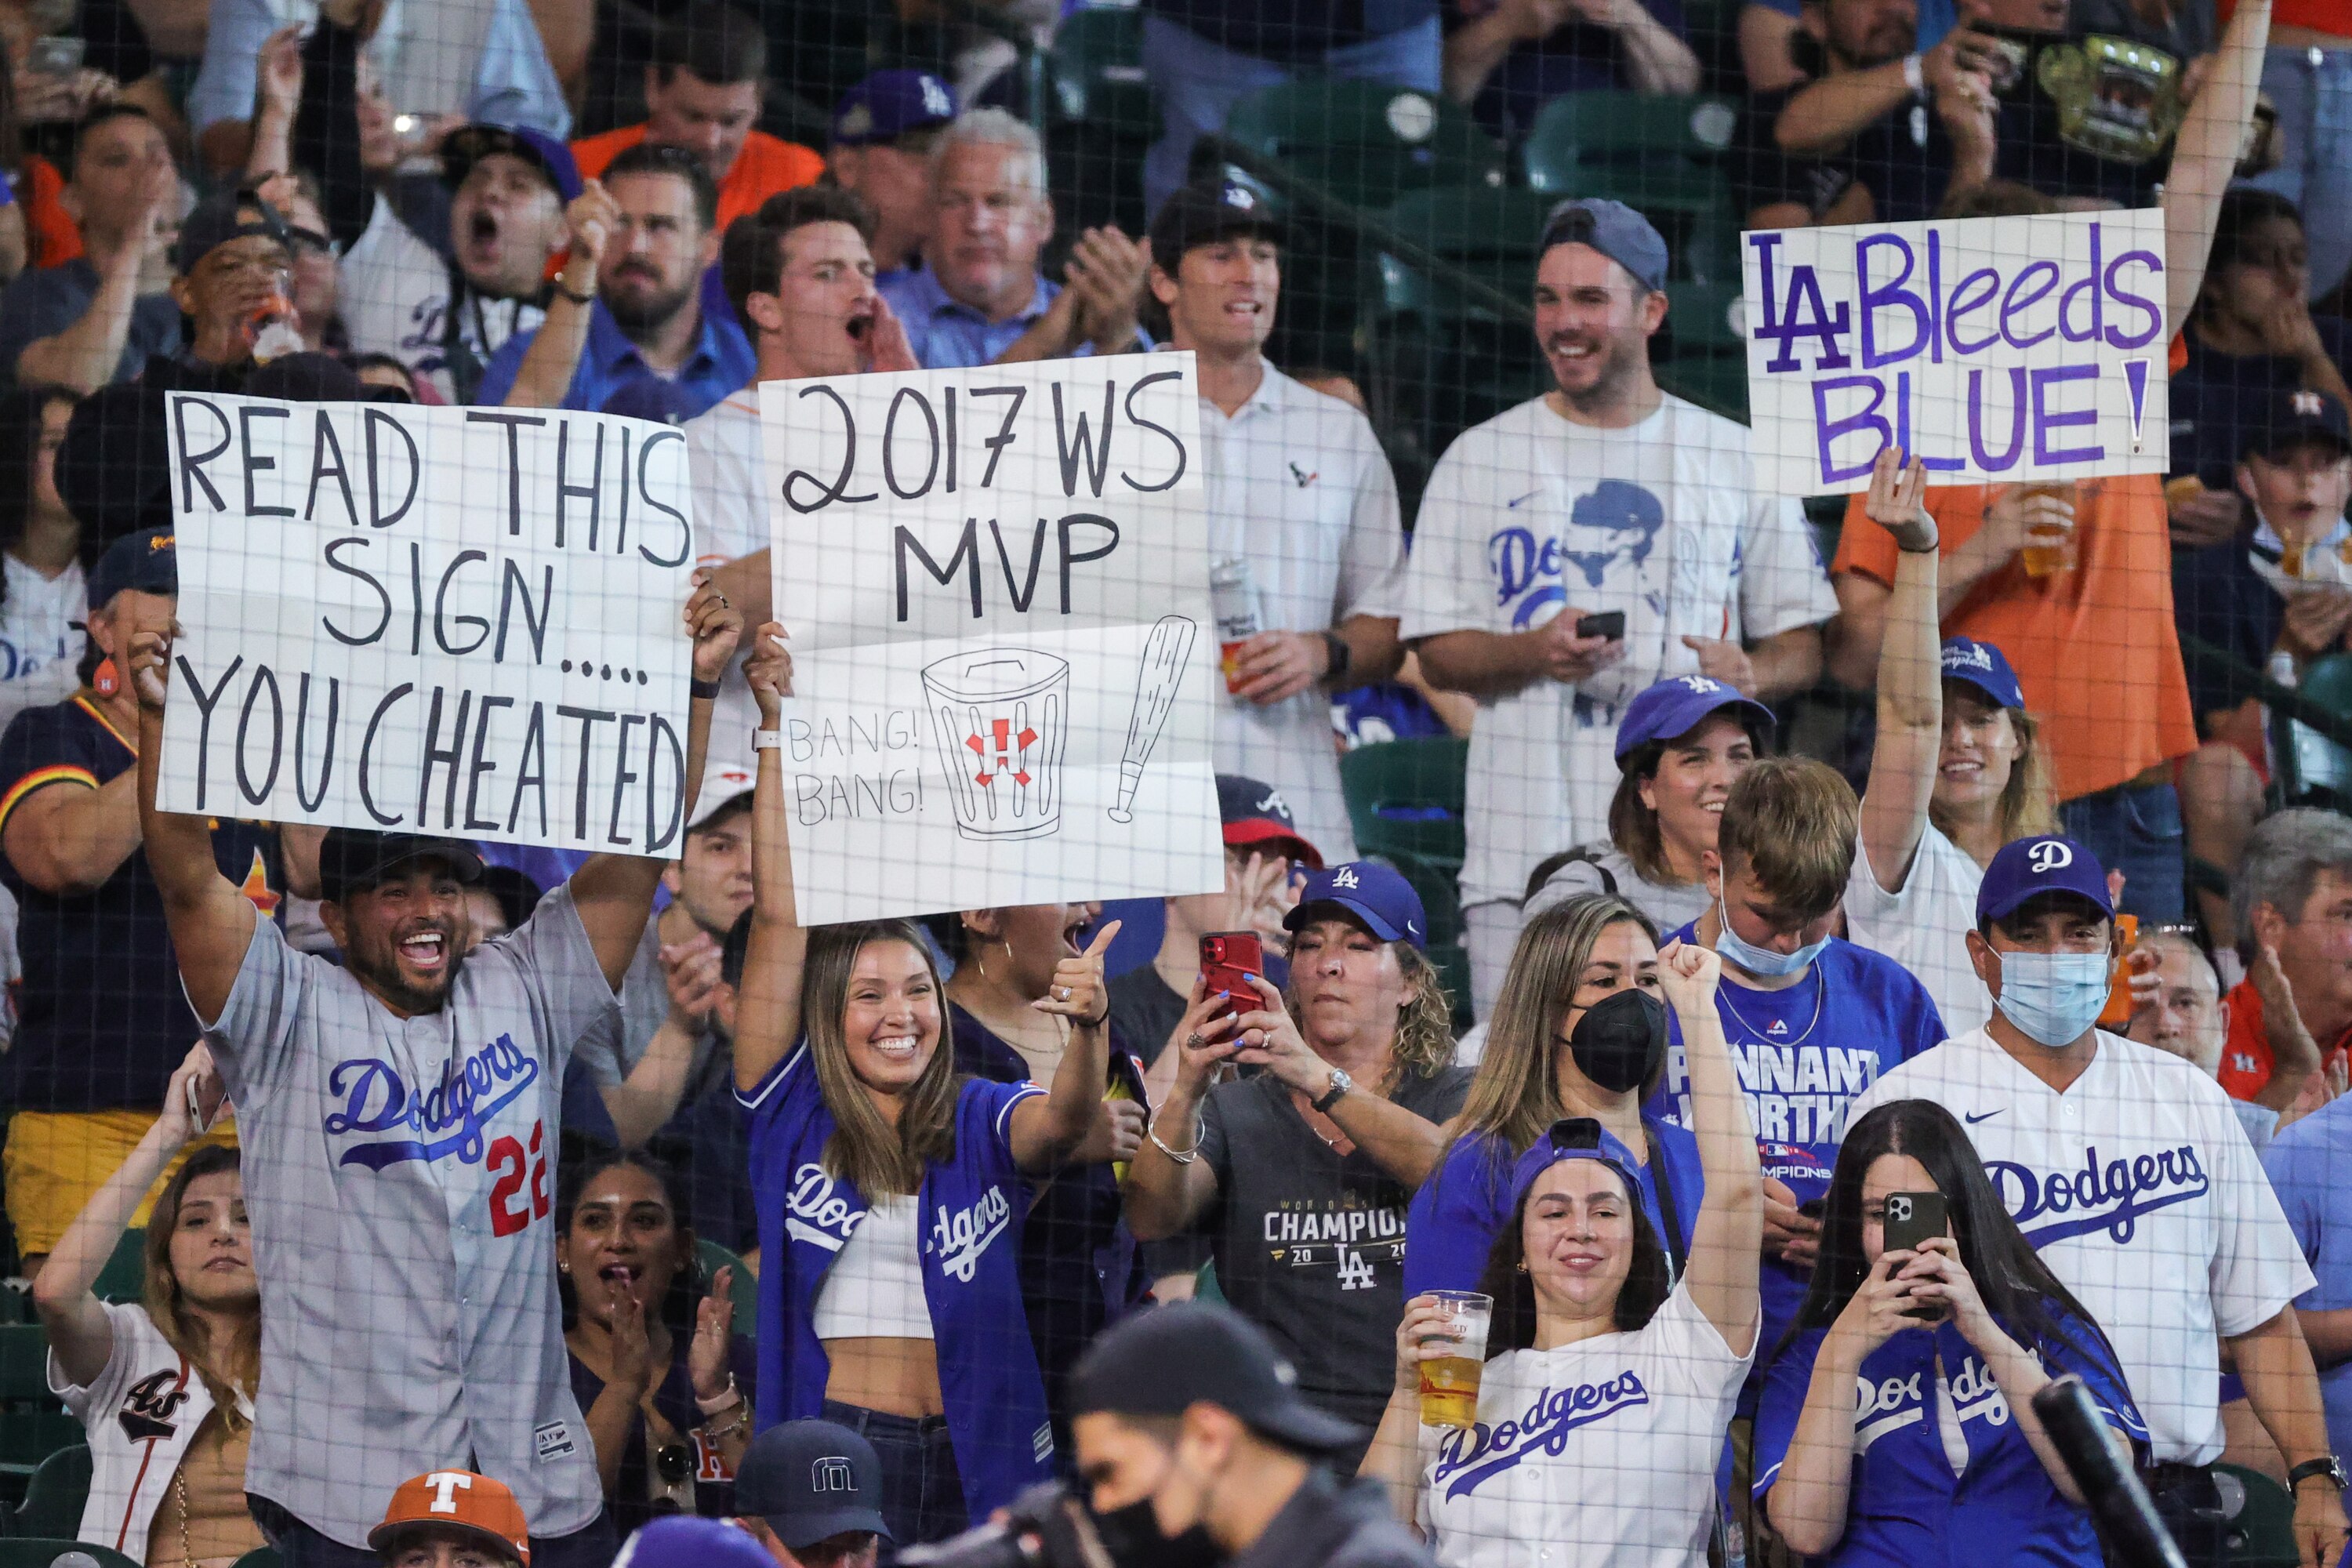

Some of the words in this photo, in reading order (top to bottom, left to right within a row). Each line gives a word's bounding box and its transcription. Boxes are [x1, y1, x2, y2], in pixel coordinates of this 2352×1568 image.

[1749, 233, 1851, 373] LA
[1856, 223, 2164, 369] Bleeds
[173, 396, 419, 528] READ
[466, 412, 691, 568] THIS
[782, 384, 1027, 514] 2017
[1051, 372, 1186, 497] WS
[895, 513, 1120, 622] MVP
[175, 655, 339, 813] YOU
[359, 682, 686, 853] CHEATED
[789, 710, 918, 762] BANG!
[795, 766, 924, 826] BANG!
[1332, 866, 1359, 889] LA
[2027, 840, 2073, 873] D
[325, 1033, 538, 1167] Dodgers
[1668, 1044, 1880, 1094] PNNANT
[1981, 1145, 2209, 1247] Dodgers
[1292, 1249, 1312, 1263] 20
[1334, 1243, 1375, 1291] LA
[1435, 1370, 1649, 1484] Dodgers
[424, 1471, 471, 1515] T
